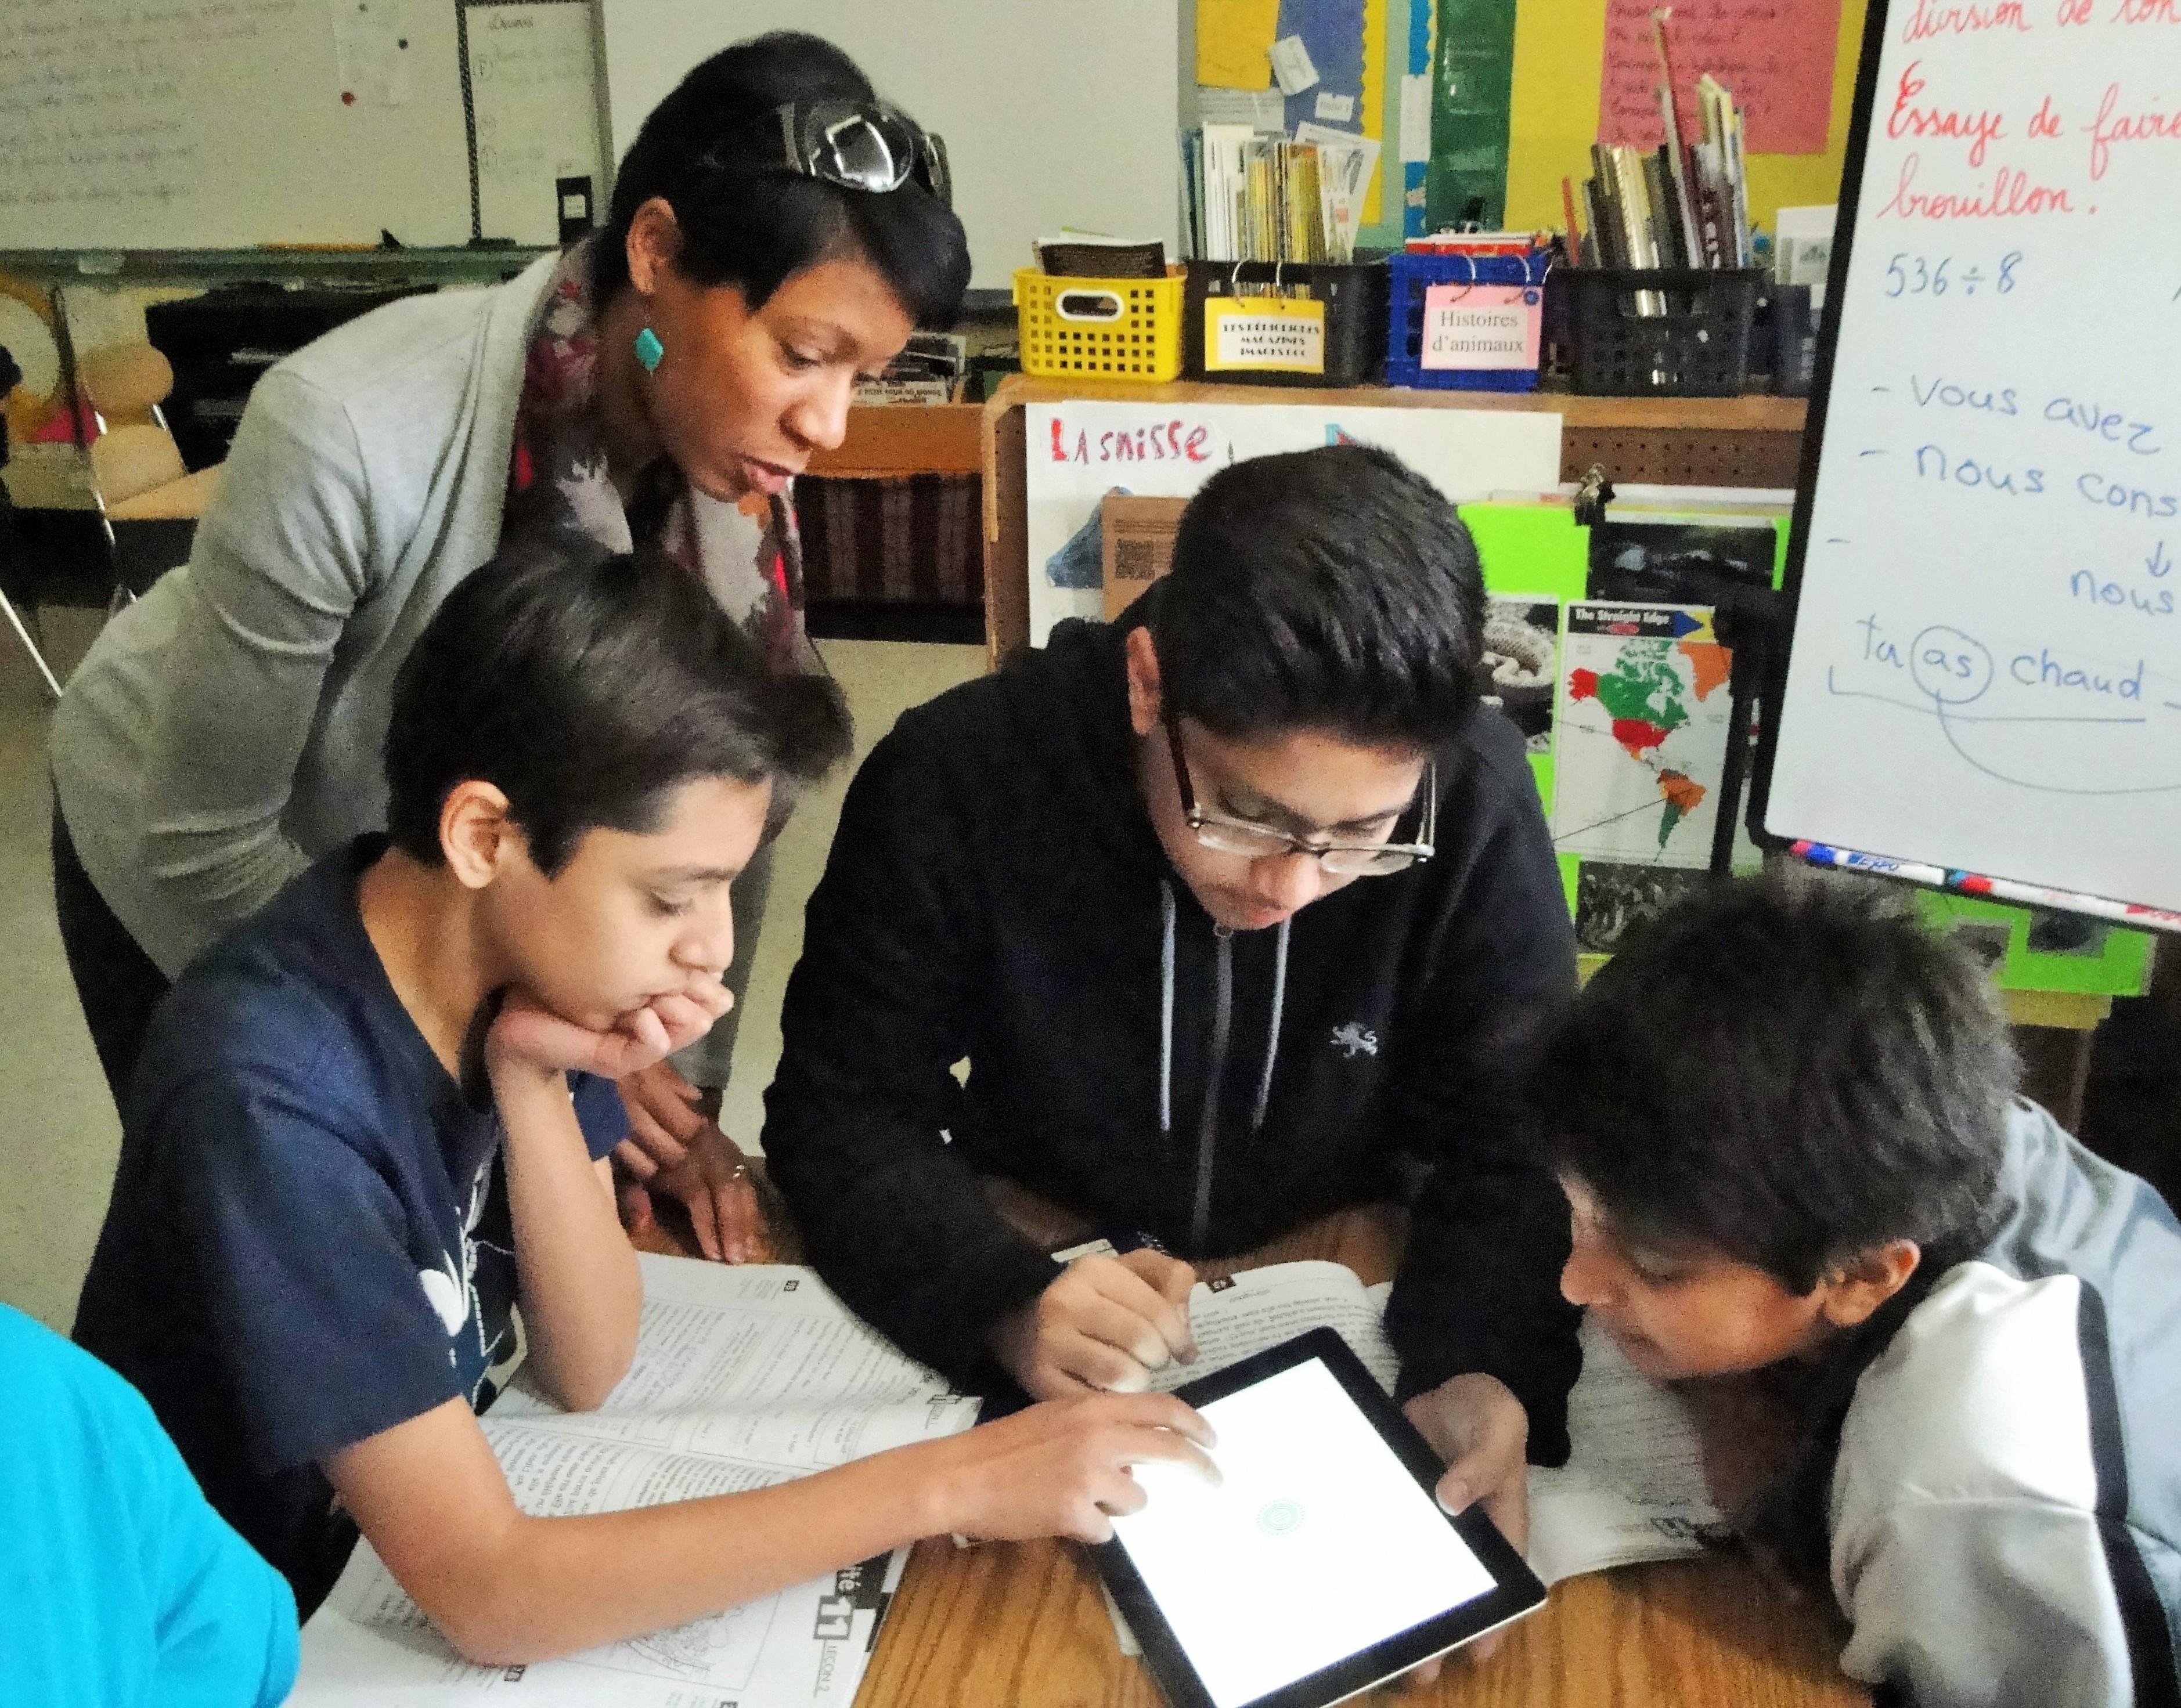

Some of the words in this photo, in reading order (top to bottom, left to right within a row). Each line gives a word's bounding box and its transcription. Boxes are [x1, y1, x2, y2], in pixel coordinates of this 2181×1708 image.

[2028, 94, 2063, 138] de
[2080, 82, 2181, 181] faire
[1440, 310, 1519, 328] Histoires
[2044, 398, 2160, 455] avez
[1575, 608, 1595, 620] The
[1923, 649, 1972, 679] as
